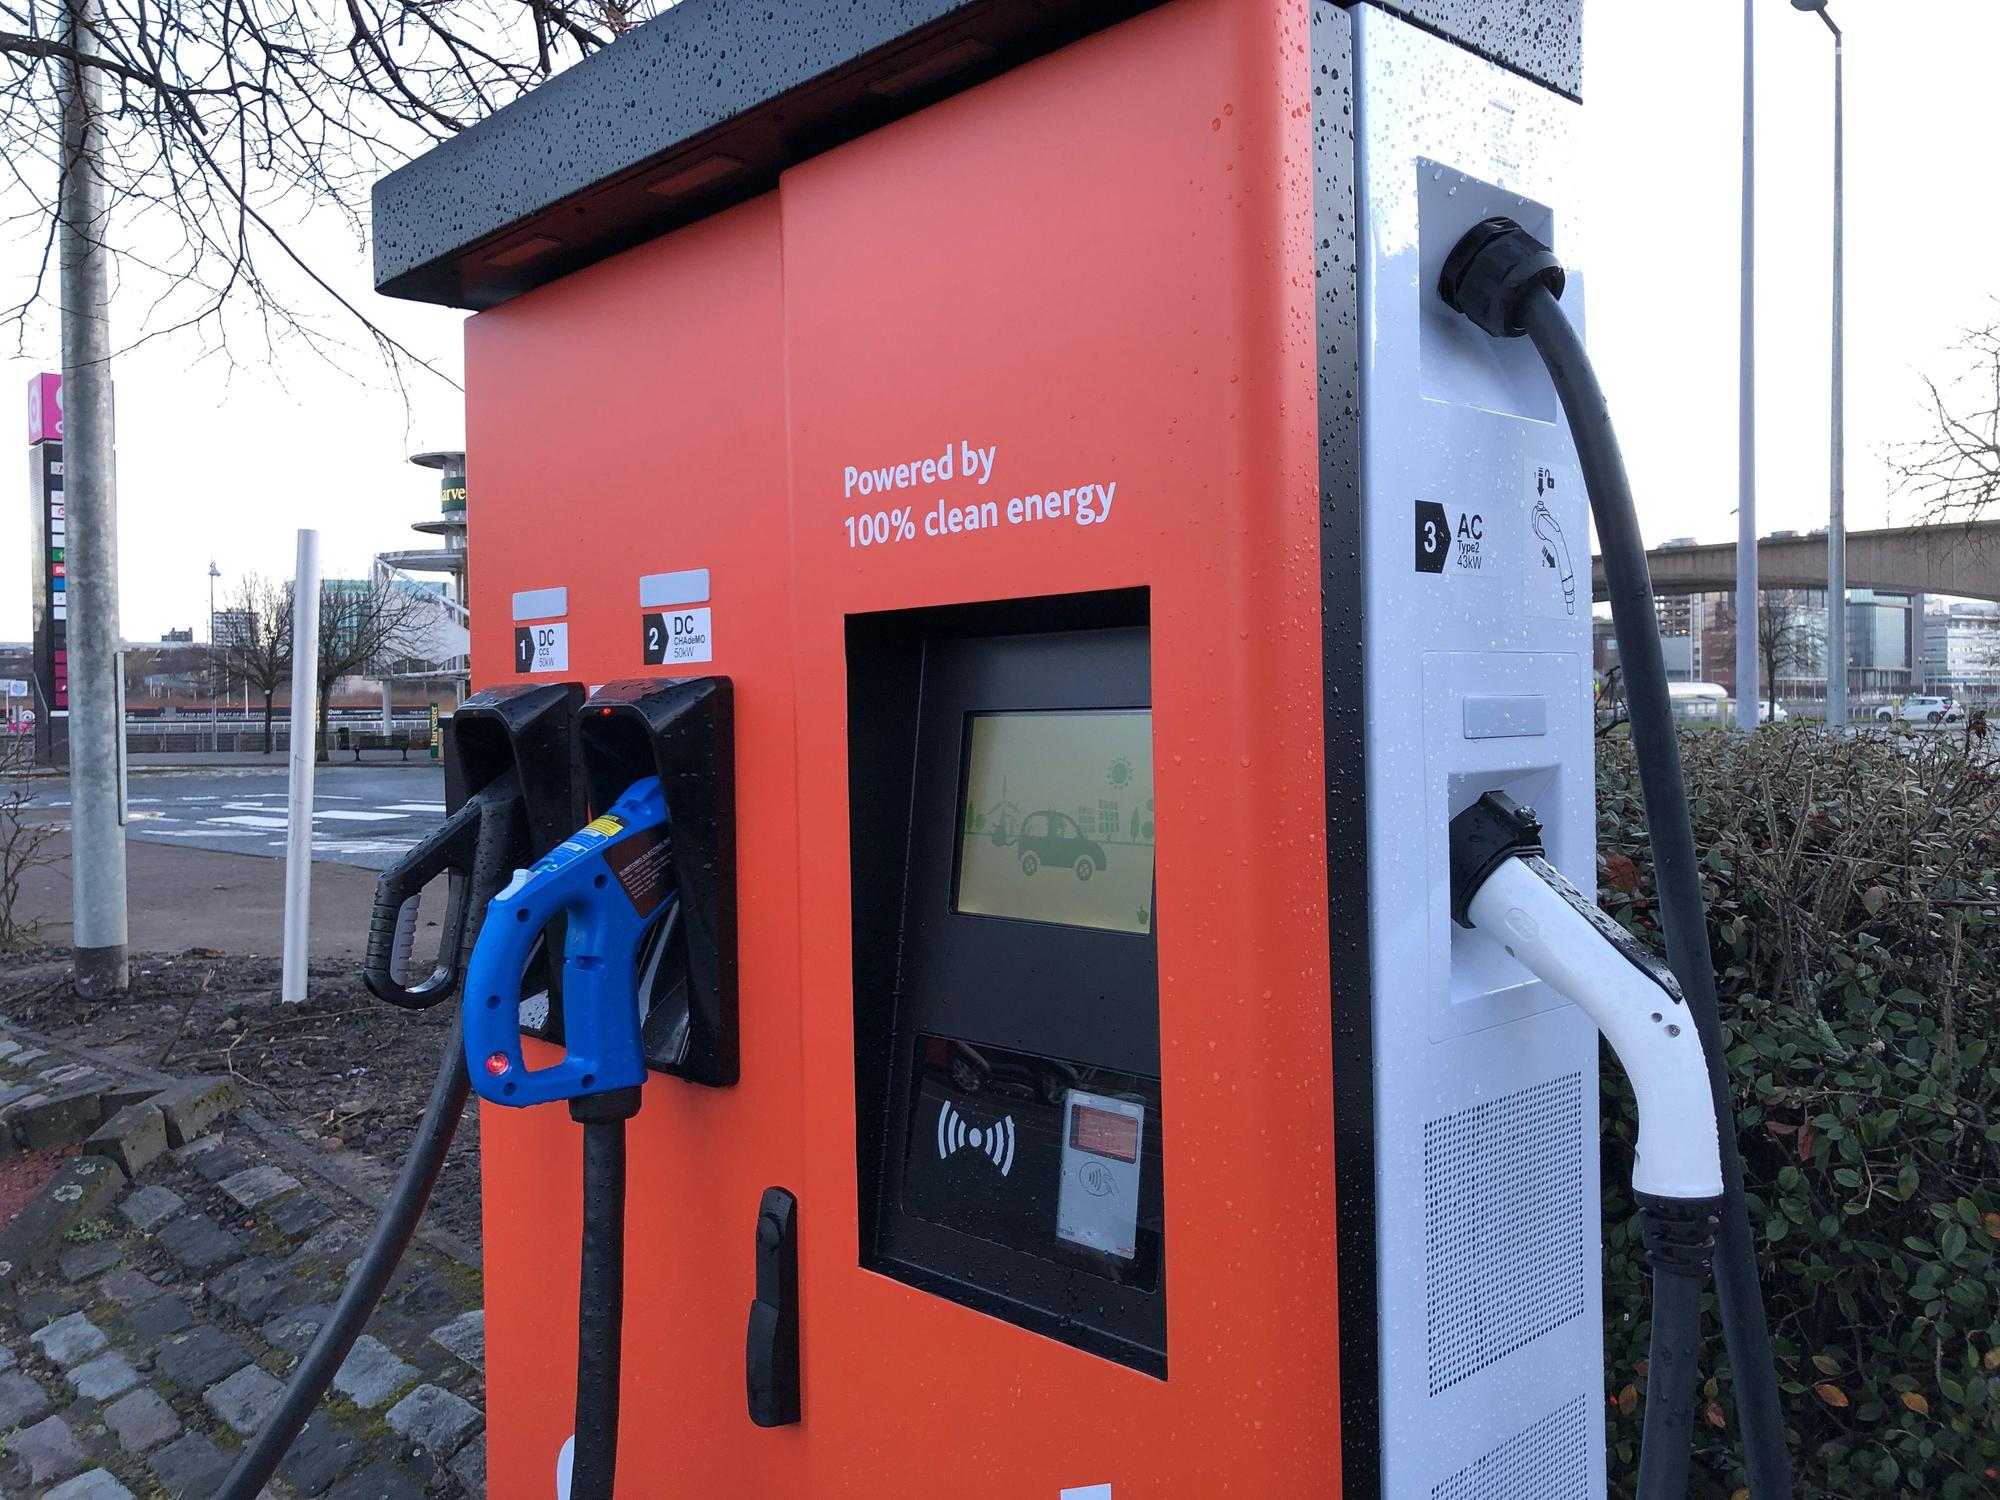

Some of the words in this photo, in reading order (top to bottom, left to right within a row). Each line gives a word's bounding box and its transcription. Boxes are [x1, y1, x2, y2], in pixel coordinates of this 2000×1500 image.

[844, 444, 953, 498] Powered
[962, 440, 996, 485] by
[440, 487, 465, 501] arve
[844, 506, 916, 548] 100%
[924, 499, 998, 537] clean
[1007, 481, 1118, 525] energy
[1457, 513, 1483, 540] AC
[1423, 521, 1437, 553] 3
[1457, 540, 1480, 554] Type2
[1457, 554, 1482, 570] 43kW
[674, 615, 695, 635] DC
[538, 629, 555, 647] DC
[649, 627, 660, 651] 2
[674, 634, 706, 646] CHAdeMO
[519, 639, 526, 660] 1
[538, 648, 550, 656] CCS
[674, 647, 695, 659] 50kW
[538, 657, 555, 667] 50kW
[430, 706, 438, 746] Harvester
